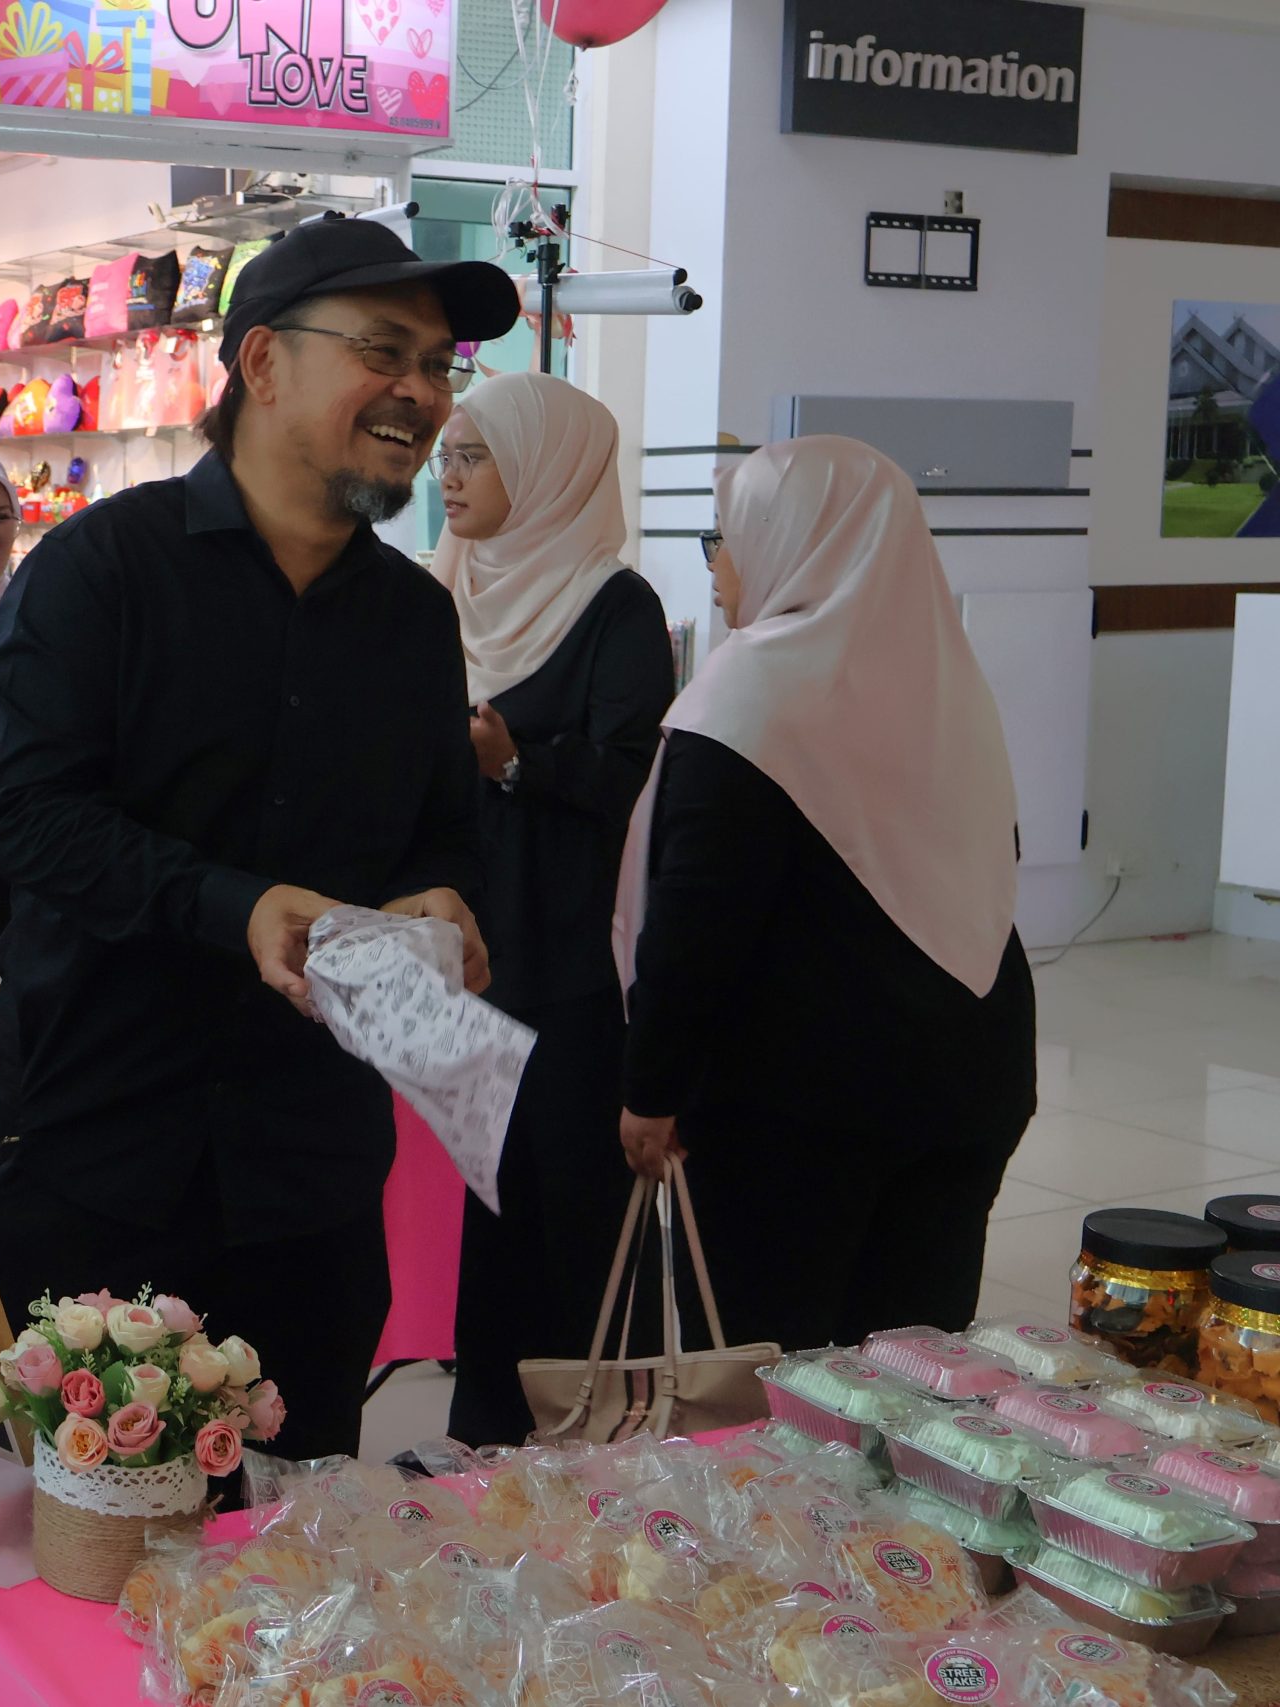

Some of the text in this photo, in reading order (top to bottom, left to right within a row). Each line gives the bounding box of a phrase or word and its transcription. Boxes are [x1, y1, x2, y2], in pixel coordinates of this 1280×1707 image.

[249, 53, 369, 113] LOVE
[806, 30, 1076, 104] information
[938, 1667, 986, 1678] STREET
[943, 1676, 985, 1687] BAKES
